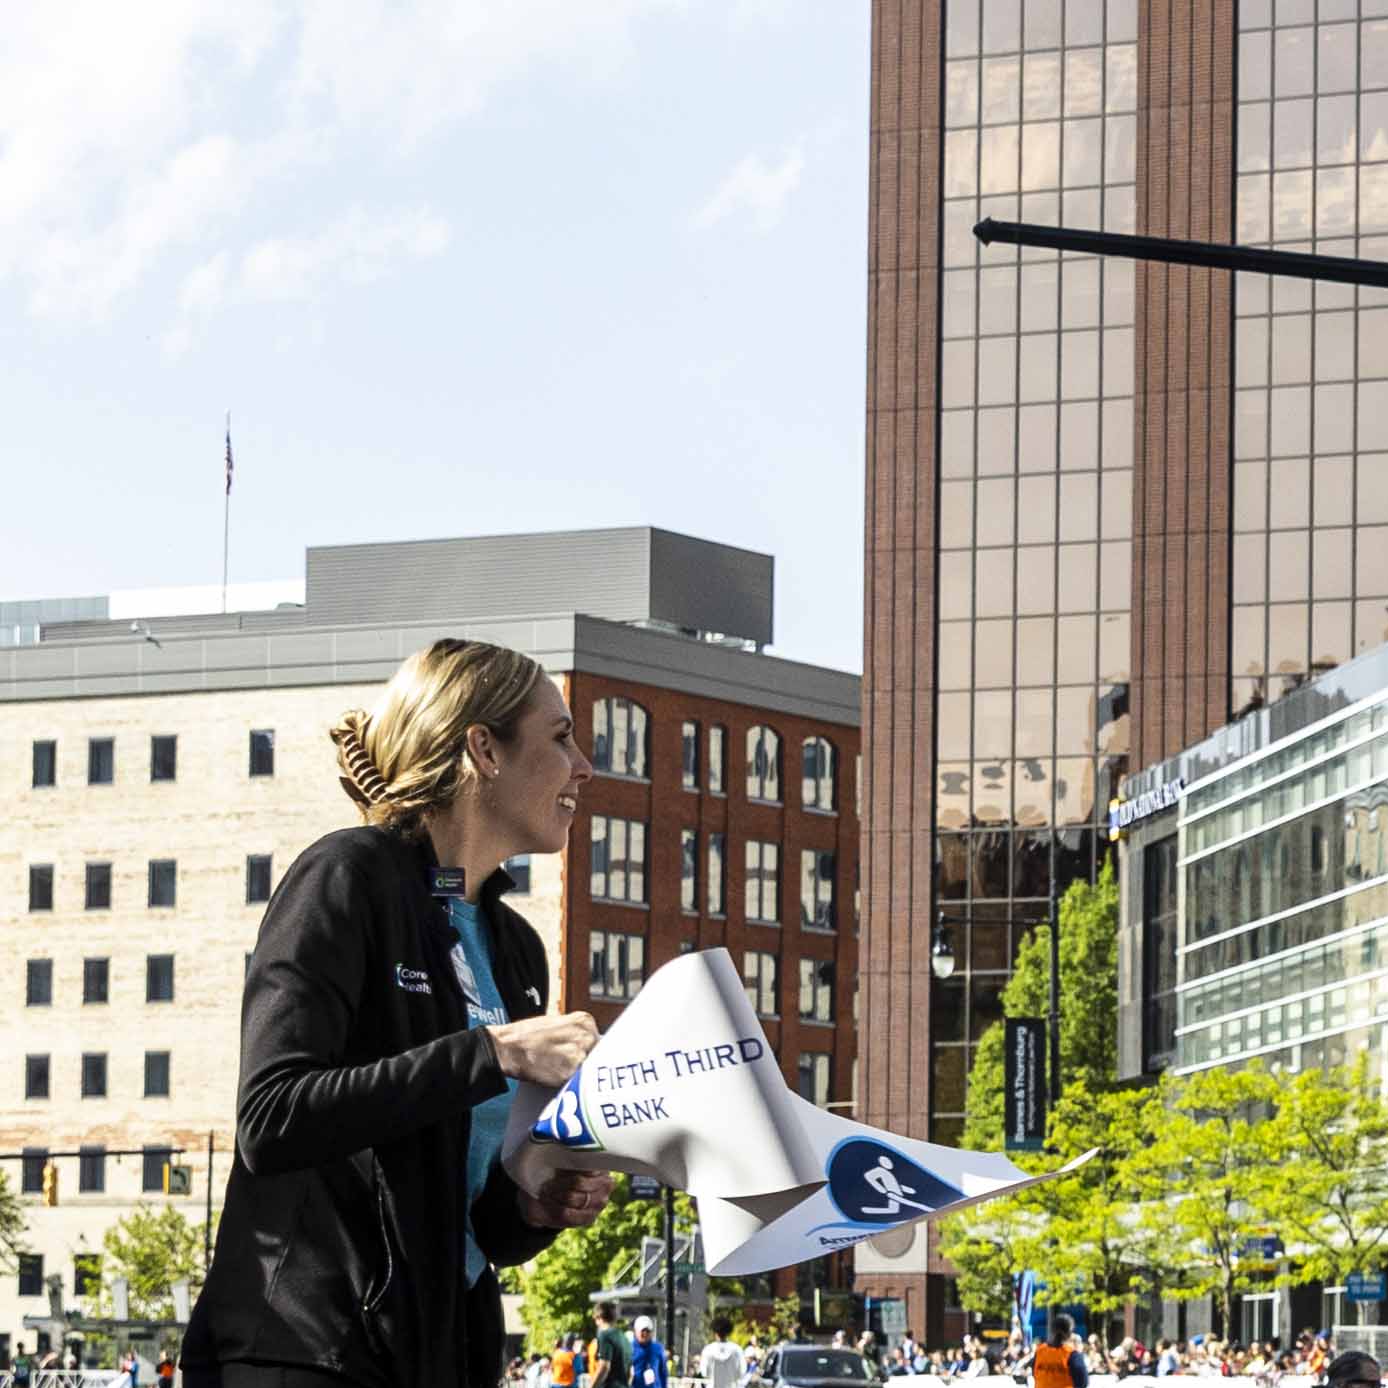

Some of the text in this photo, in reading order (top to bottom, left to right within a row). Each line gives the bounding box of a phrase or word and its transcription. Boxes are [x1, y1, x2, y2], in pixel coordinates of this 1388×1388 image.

[596, 1037, 765, 1092] FIFTH THIRD
[600, 1096, 671, 1129] BANK
